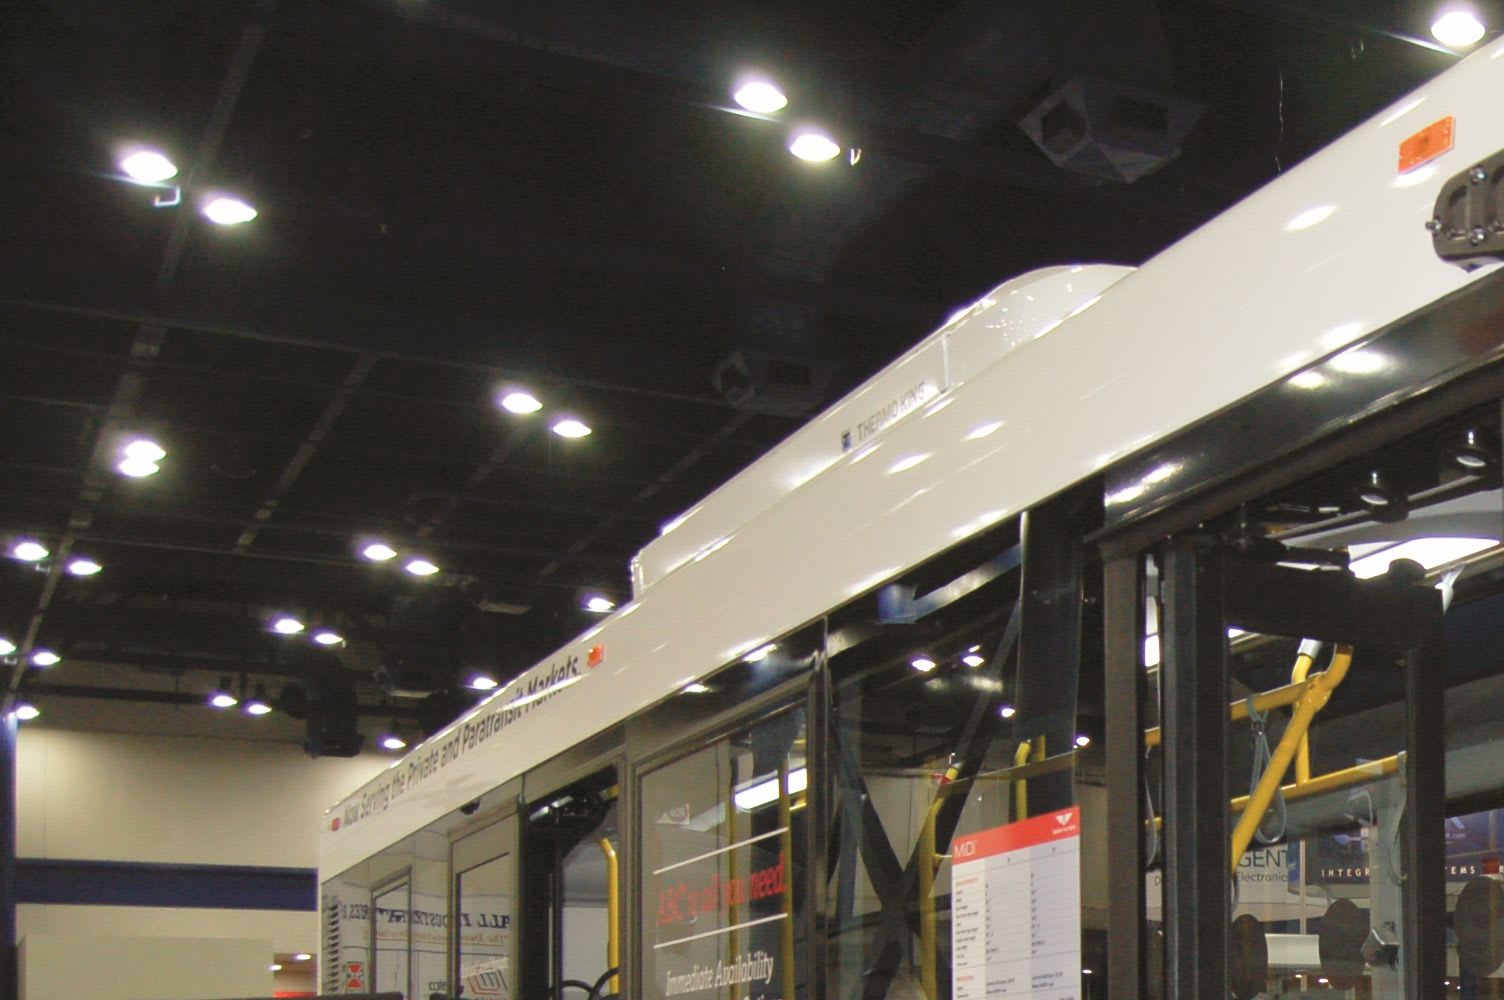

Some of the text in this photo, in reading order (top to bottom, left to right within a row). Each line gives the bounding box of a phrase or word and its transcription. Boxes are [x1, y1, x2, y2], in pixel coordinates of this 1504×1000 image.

[857, 398, 899, 441] THERMO
[361, 781, 390, 818] Serving
[392, 772, 405, 800] the
[407, 749, 439, 790] Private
[440, 734, 460, 771] and
[462, 690, 524, 755] Paratransit
[1321, 867, 1371, 878] INTEGR
[665, 949, 774, 997] Immediate Availability
